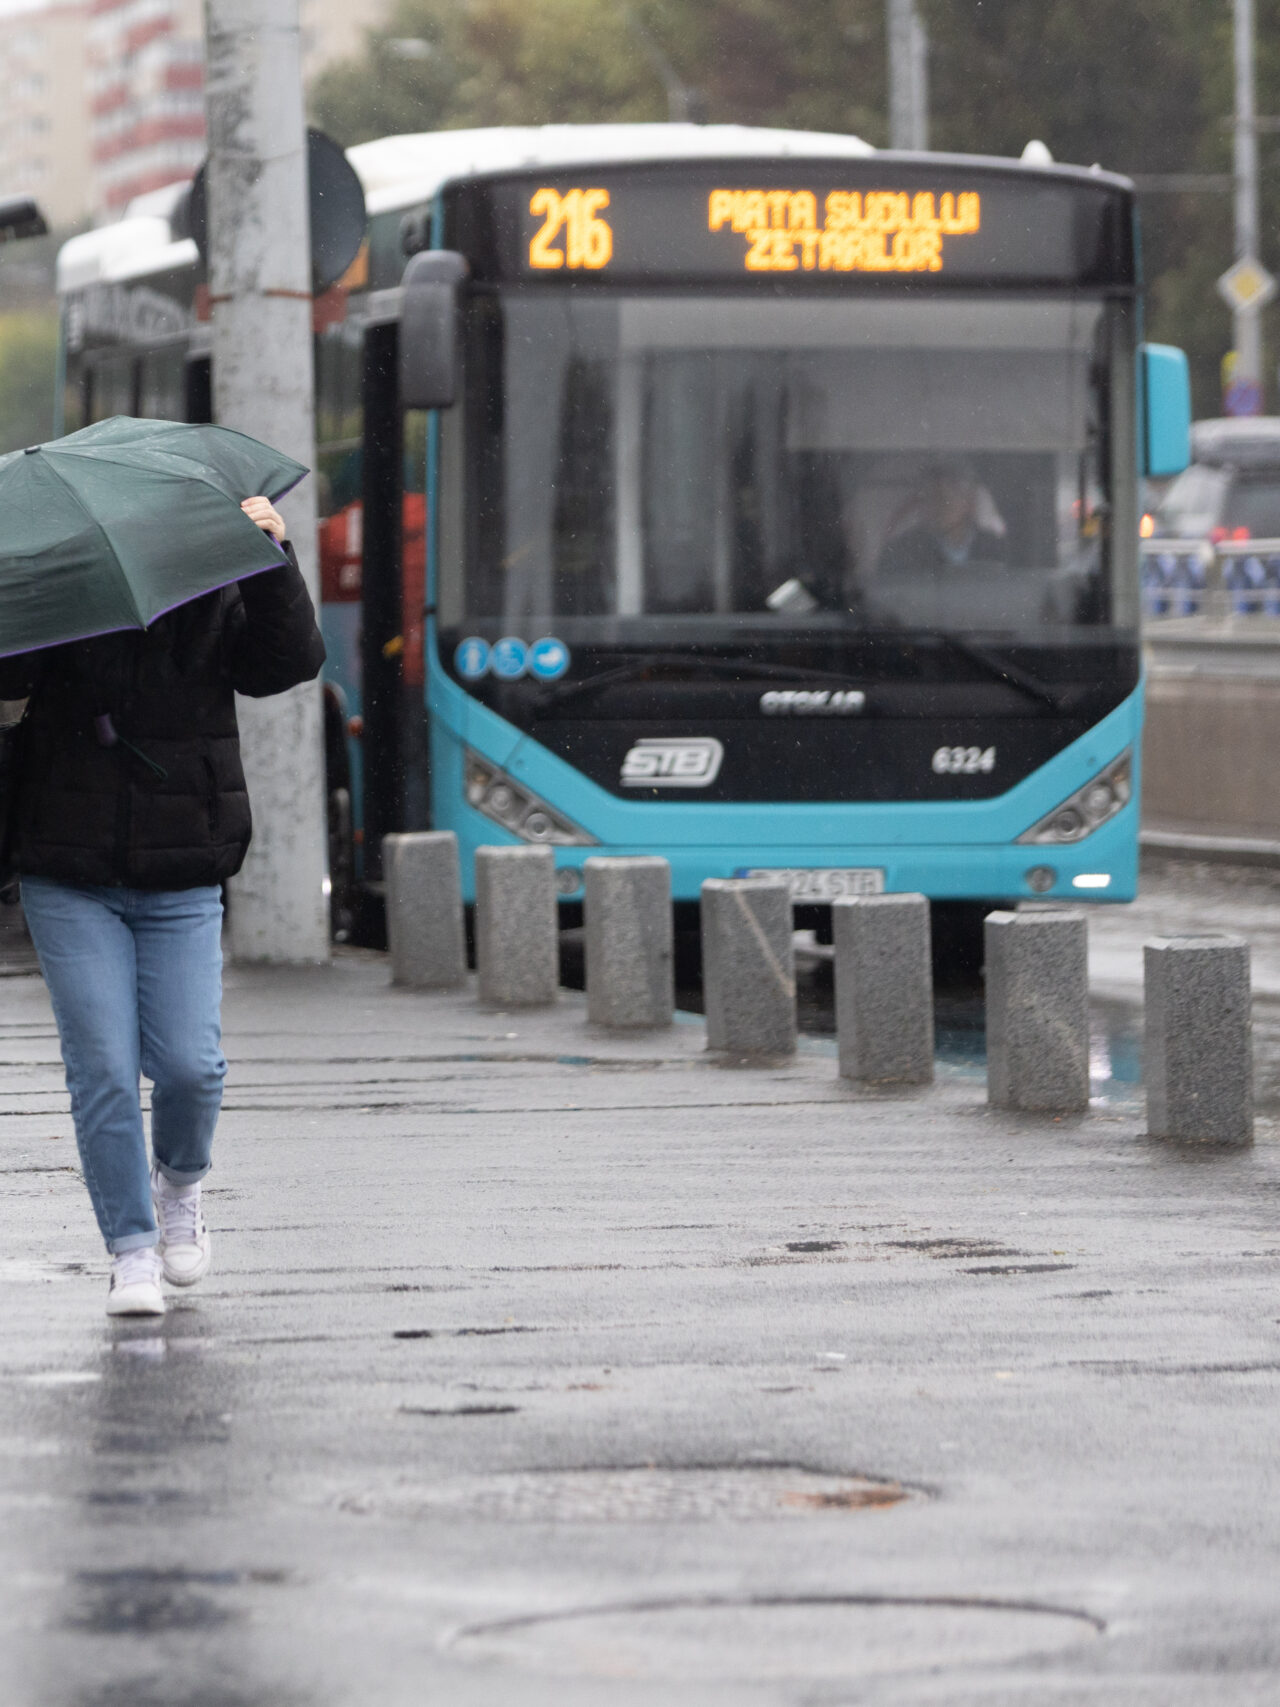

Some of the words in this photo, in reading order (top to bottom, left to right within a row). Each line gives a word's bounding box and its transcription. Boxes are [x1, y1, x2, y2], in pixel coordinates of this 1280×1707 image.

[529, 188, 612, 269] 216
[708, 189, 817, 233] PIATA
[621, 747, 709, 776] STB
[932, 746, 996, 774] 6324
